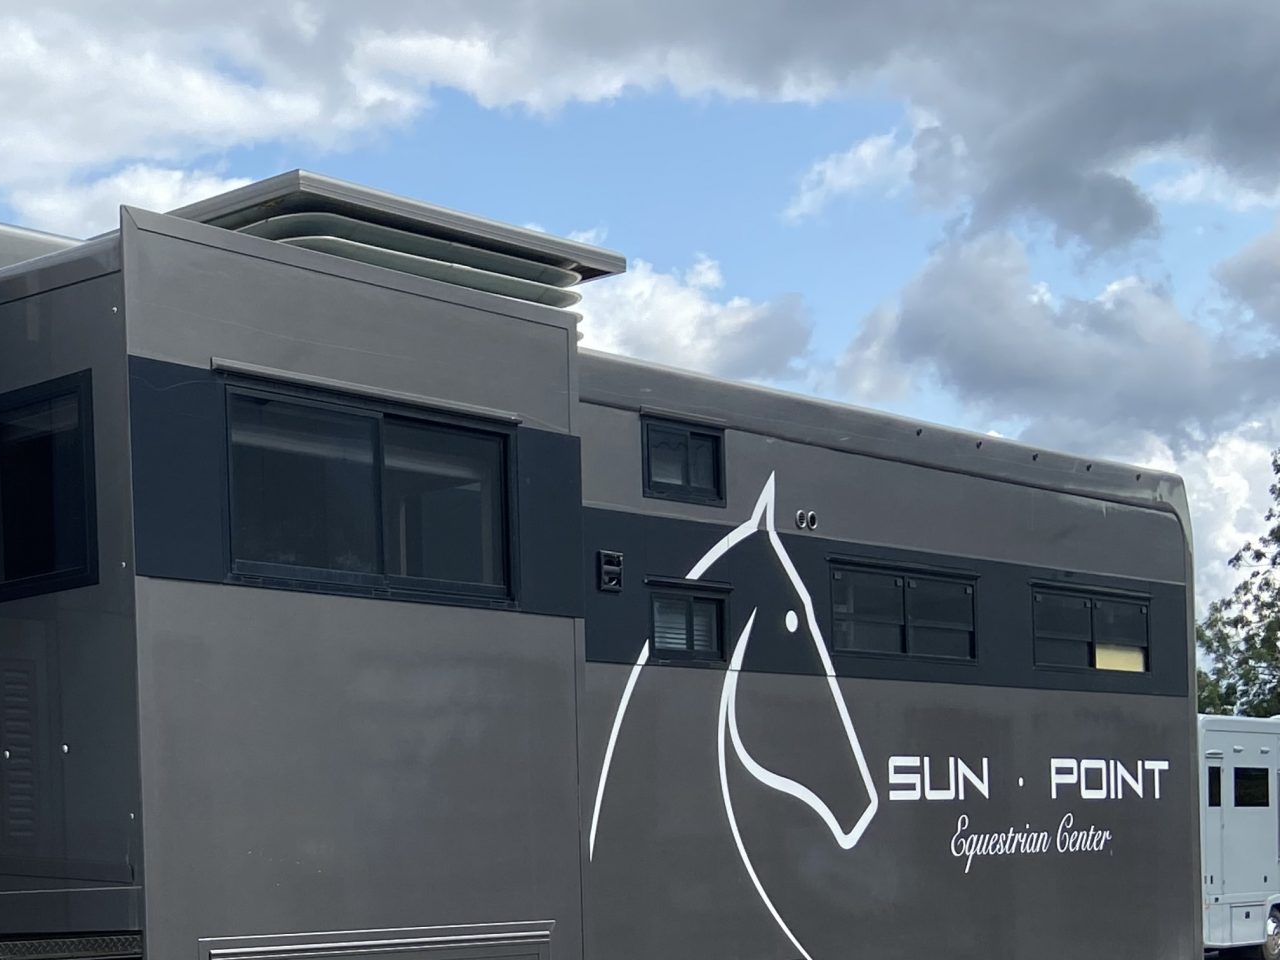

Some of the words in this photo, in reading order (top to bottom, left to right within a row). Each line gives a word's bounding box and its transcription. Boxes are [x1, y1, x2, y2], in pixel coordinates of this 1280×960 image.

[888, 756, 989, 801] SUN
[1050, 758, 1169, 800] POINT
[950, 814, 1052, 874] Equestrian
[1056, 812, 1113, 853] Center
